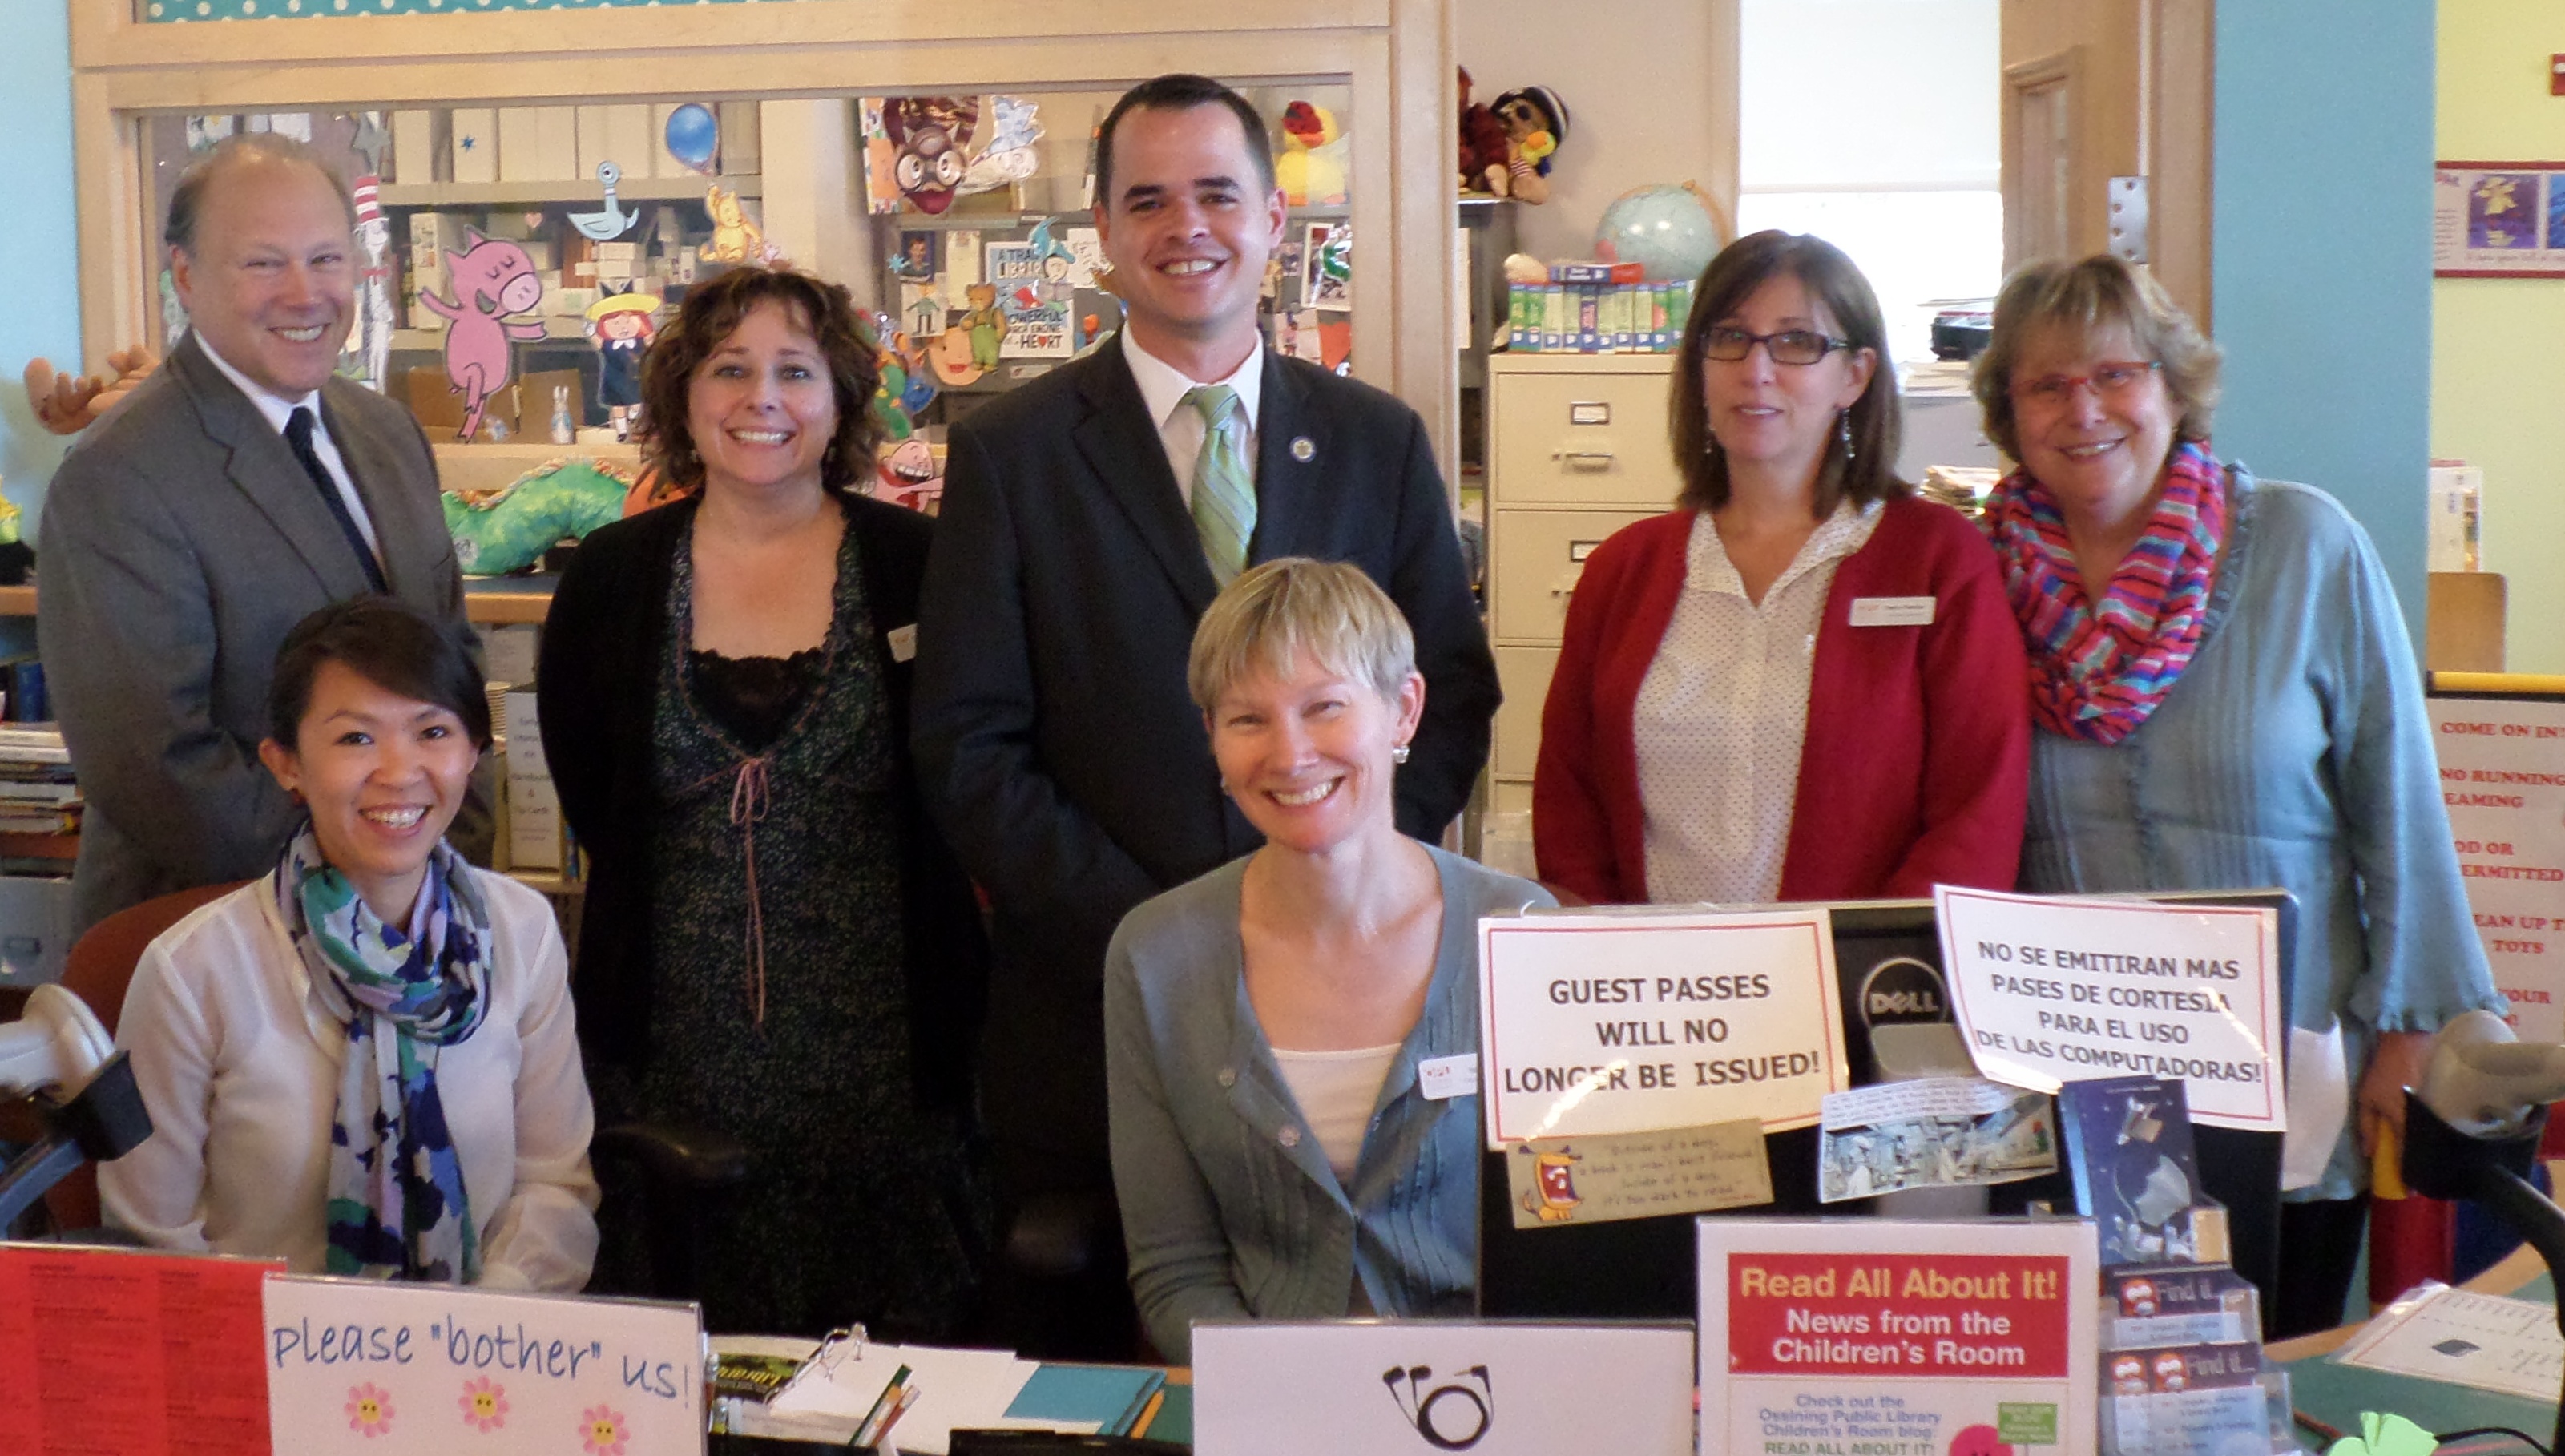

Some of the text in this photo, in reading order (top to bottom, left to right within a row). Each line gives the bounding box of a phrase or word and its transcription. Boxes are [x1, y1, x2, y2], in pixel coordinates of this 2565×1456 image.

[2441, 722, 2495, 736] COME
[2502, 724, 2530, 736] ON
[2445, 793, 2523, 808] EAMING
[2454, 841, 2482, 854] OD
[2462, 865, 2564, 881] ERMITTED
[2474, 914, 2515, 928] EAN
[2551, 918, 2565, 931] T
[1978, 940, 2240, 980] NO SE EMITIRAN MAS
[1549, 974, 1771, 1005] GUEST PASSES
[1991, 974, 2063, 1000] PASES
[2071, 983, 2101, 1004] DE
[1870, 990, 1940, 1015] DELL
[1596, 1018, 1728, 1047] WILL NO
[2039, 1010, 2189, 1044] PARA EL USO
[1975, 1030, 2262, 1083] DE LAS COMPUTADORAS!
[1639, 1063, 1676, 1089] BE
[1695, 1051, 1821, 1087] ISSUED!
[1741, 1268, 2058, 1300] Read All About It!
[1786, 1309, 2012, 1336] News from the
[430, 1313, 603, 1379] "bother"
[622, 1353, 690, 1408] us!
[1772, 1339, 2026, 1365] Children's Room
[1795, 1394, 1905, 1408] Check out the
[1833, 1410, 1881, 1422] Public
[1887, 1410, 1942, 1424] Library
[1848, 1425, 1894, 1437] Room
